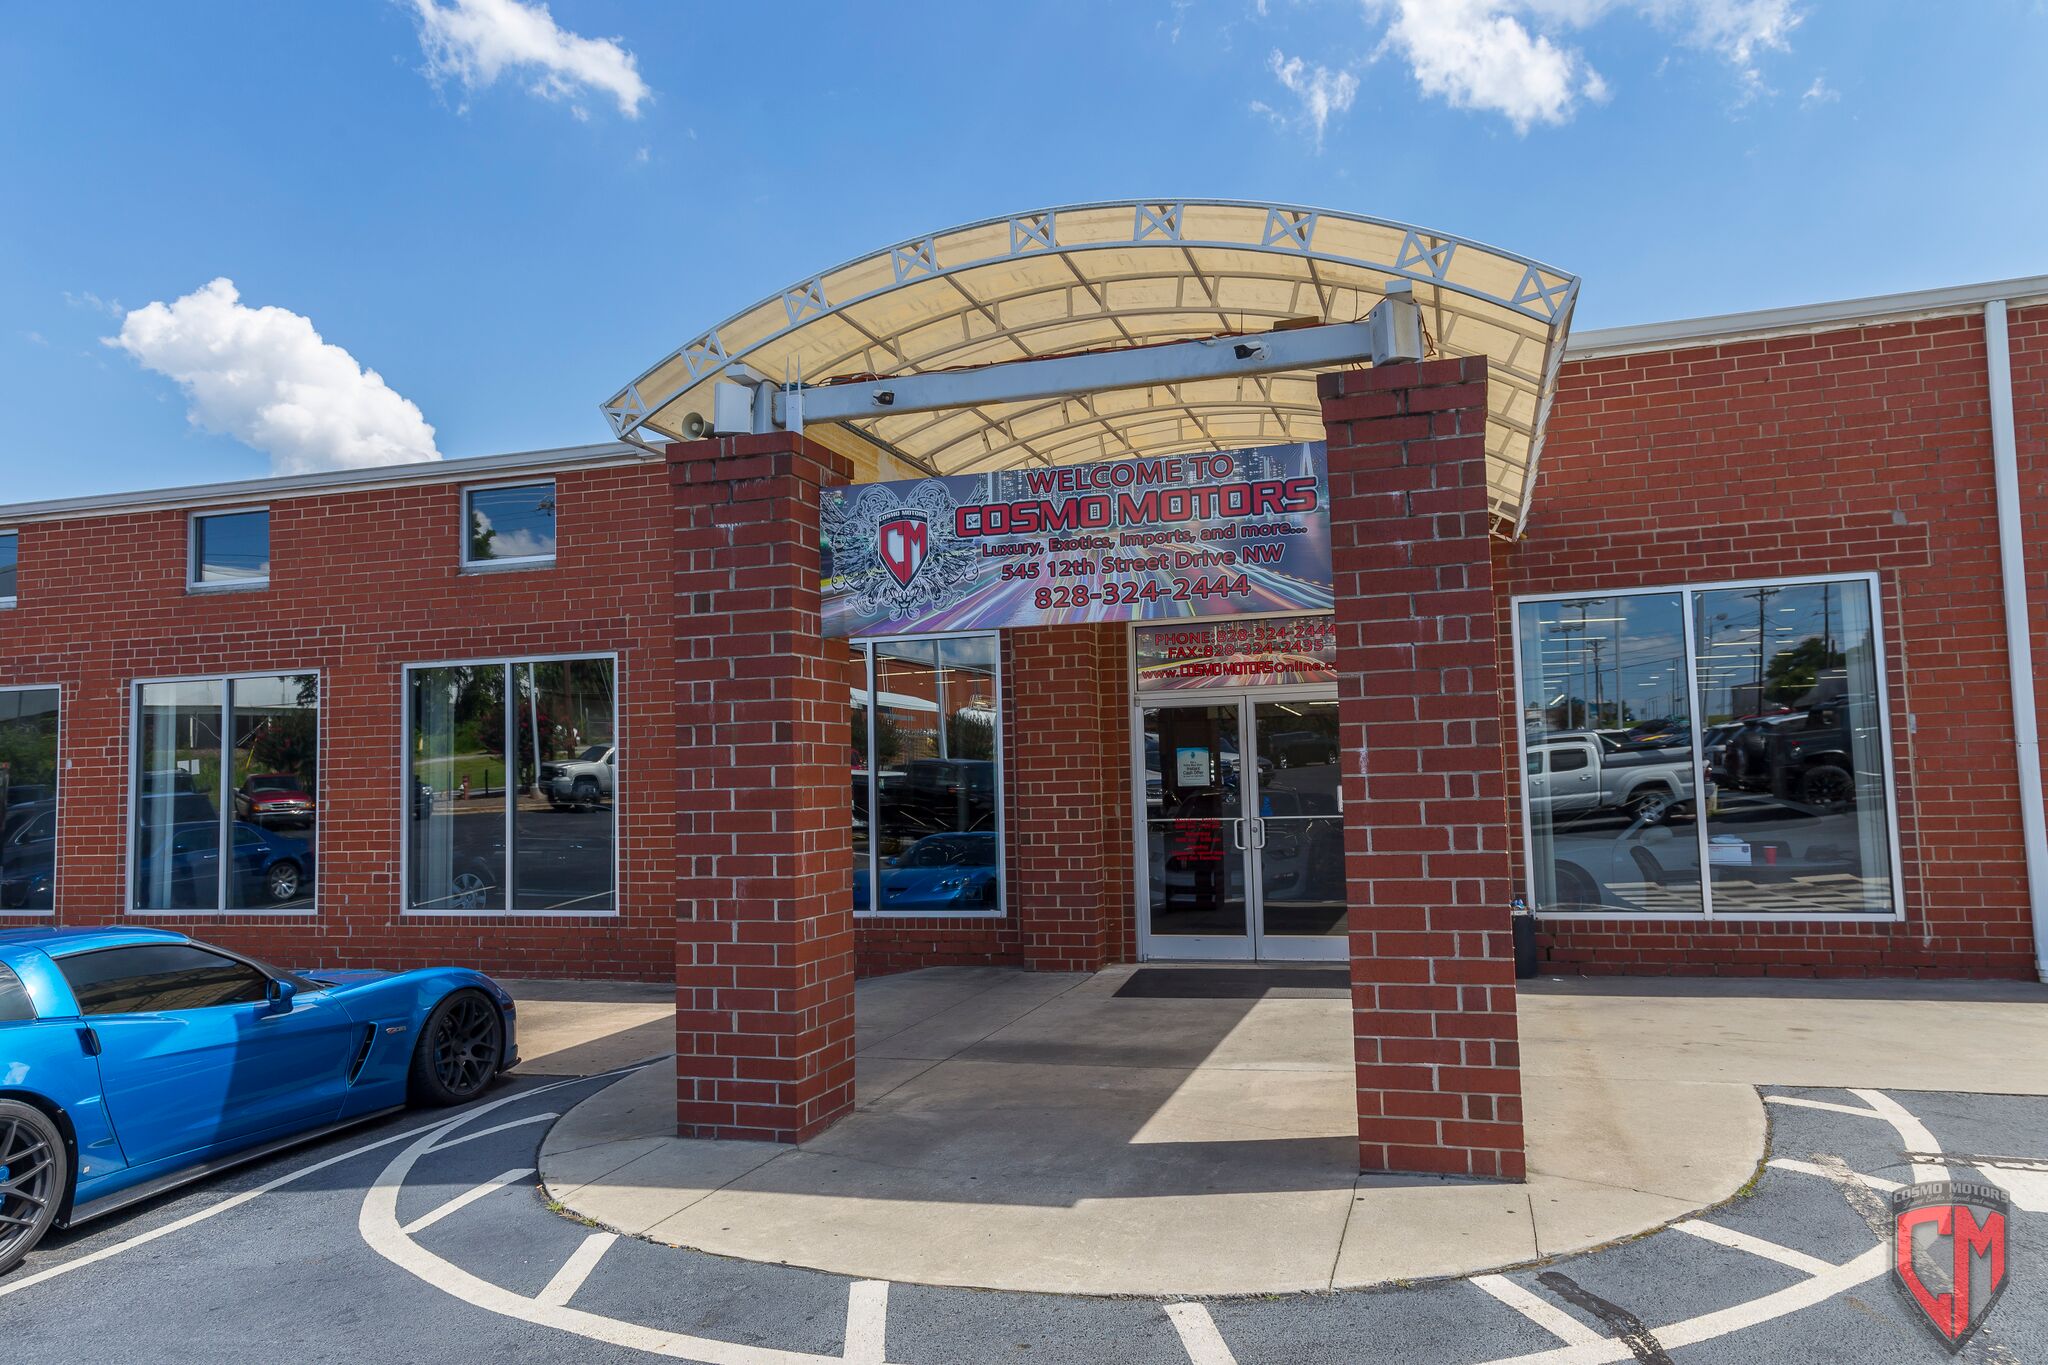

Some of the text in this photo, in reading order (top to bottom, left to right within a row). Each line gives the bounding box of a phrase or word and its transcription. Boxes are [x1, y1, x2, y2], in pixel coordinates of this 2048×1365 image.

[1026, 453, 1235, 495] WELCOME TO
[955, 476, 1318, 538] COSMO MOTORS
[982, 522, 1308, 558] Luxury, Exotics, Imports, and more...
[1001, 543, 1286, 581] 545 12th Street Drive NW
[1034, 573, 1252, 610] 828-324-2444
